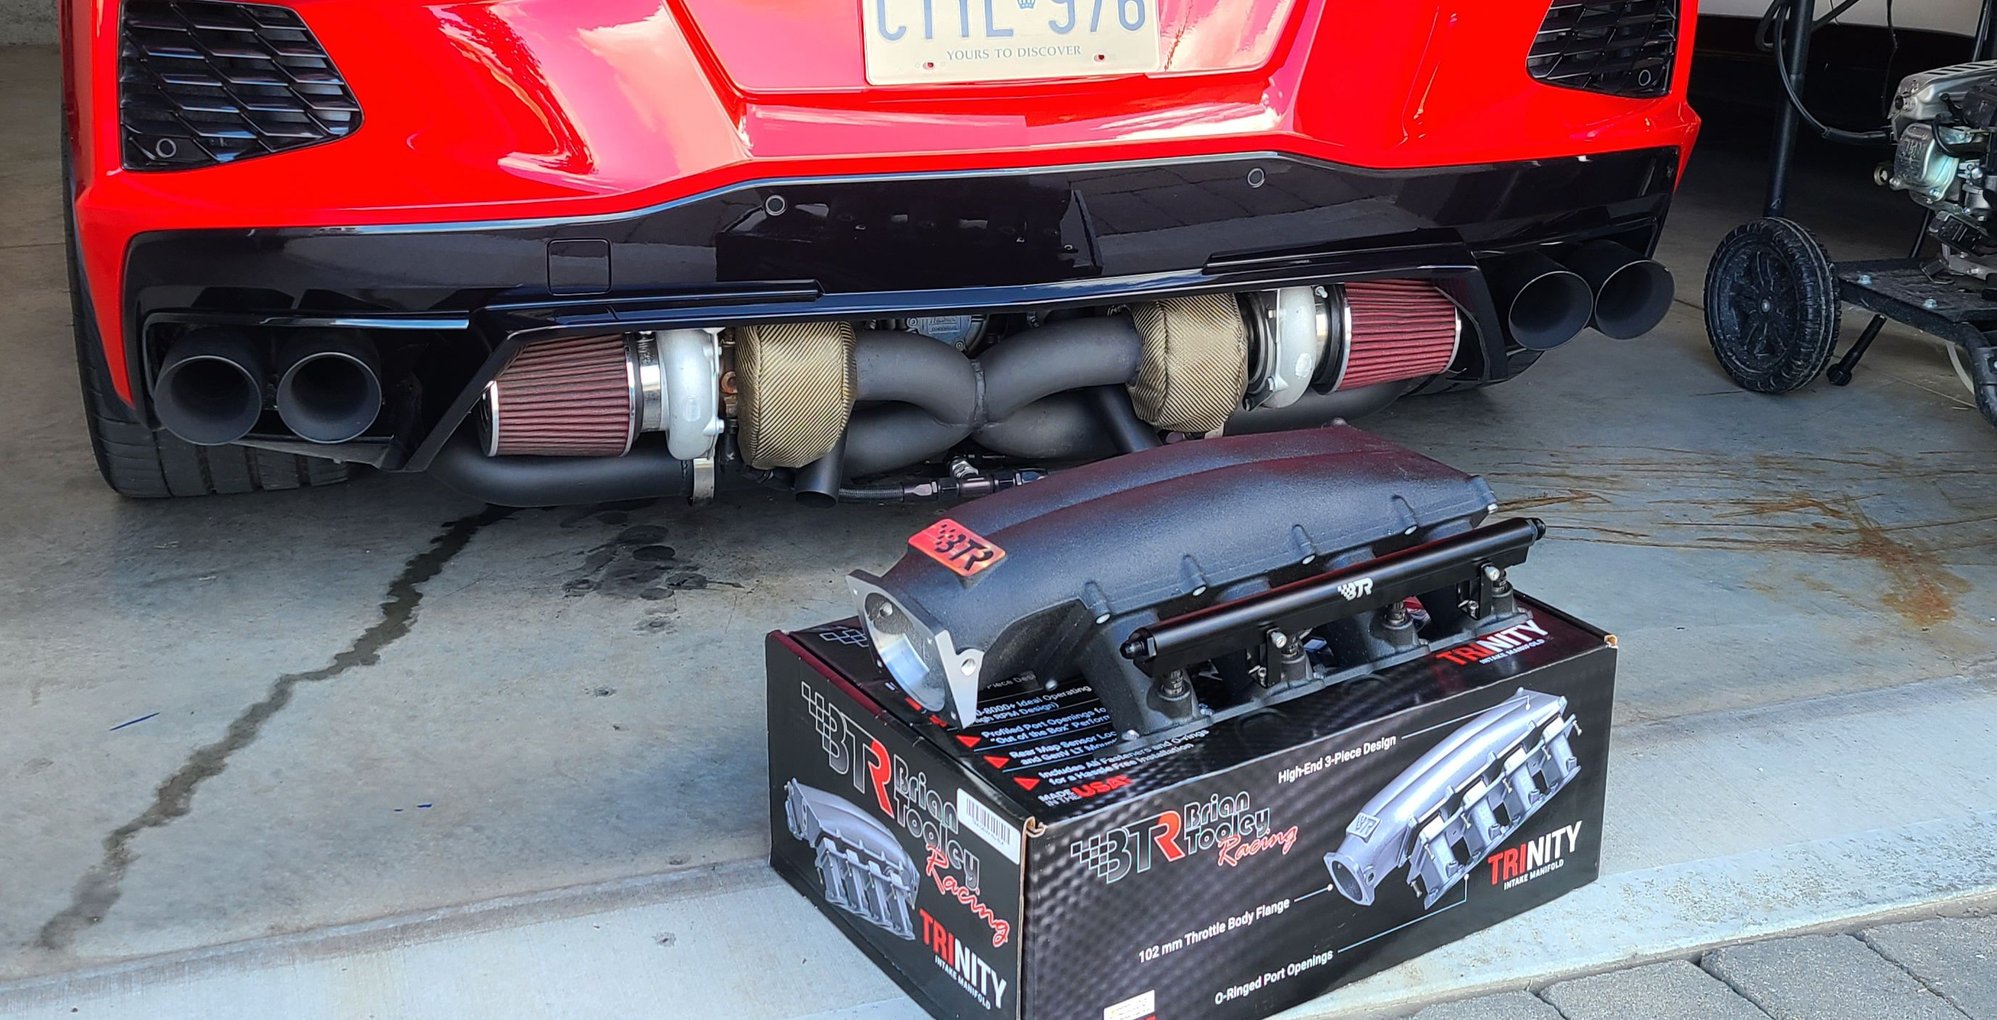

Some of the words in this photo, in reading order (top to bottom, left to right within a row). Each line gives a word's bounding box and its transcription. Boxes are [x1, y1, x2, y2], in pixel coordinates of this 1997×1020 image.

[946, 48, 990, 61] YOURS
[995, 48, 1013, 59] TO
[1017, 45, 1082, 58] DISCOVER
[934, 524, 995, 571] BTR
[1337, 577, 1374, 601] BTR
[1436, 619, 1549, 665] TRINITY
[1479, 652, 1508, 665] INTAKE
[1505, 639, 1545, 656] MANIFOLD
[993, 710, 1020, 720] RPM
[1016, 696, 1043, 708] Ideal
[1043, 685, 1092, 700] Operating
[981, 724, 1024, 738] Profiled
[1022, 719, 1048, 731] Port
[1047, 711, 1095, 726] Openings
[1009, 748, 1036, 759] Rear
[1035, 744, 1061, 754] Map
[1060, 735, 1097, 748] Sensor
[1096, 730, 1117, 740] Loc
[1029, 728, 1048, 738] the
[801, 680, 895, 820] BTR
[1020, 754, 1043, 765] and
[1069, 746, 1084, 755] LT
[1038, 763, 1086, 779] Includes
[1085, 759, 1102, 769] All
[1099, 747, 1152, 765] Fasteners
[1151, 740, 1172, 751] and
[1049, 776, 1067, 785] for
[1136, 743, 1194, 763] Installation
[1278, 757, 1323, 784] High-End
[1324, 746, 1362, 769] 3-Piece
[1363, 735, 1397, 756] Design
[893, 753, 959, 834] Brian
[1038, 788, 1072, 802] MADE
[1060, 792, 1082, 804] THE
[1184, 791, 1250, 831] Brian
[893, 788, 980, 892] Tooley
[1070, 810, 1186, 884] BTR
[1184, 808, 1270, 855] Tooley
[1217, 825, 1298, 867] Racing
[1487, 820, 1583, 886] TRINITY
[1503, 873, 1529, 891] INTAKE
[1529, 858, 1565, 880] MANIFOLD
[925, 843, 1010, 951] Racing
[1138, 945, 1160, 963] 102
[1161, 938, 1183, 956] mm
[1184, 921, 1227, 946] Throttle
[1227, 910, 1255, 931] Body
[1255, 898, 1290, 920] Flange
[918, 907, 1007, 1009] TRINITY
[1214, 975, 1262, 1005] O-Ringed
[1263, 967, 1286, 986] Port
[1286, 950, 1334, 976] Openings
[934, 954, 957, 981] INTAKE
[957, 974, 991, 1010] MANIFOLD
